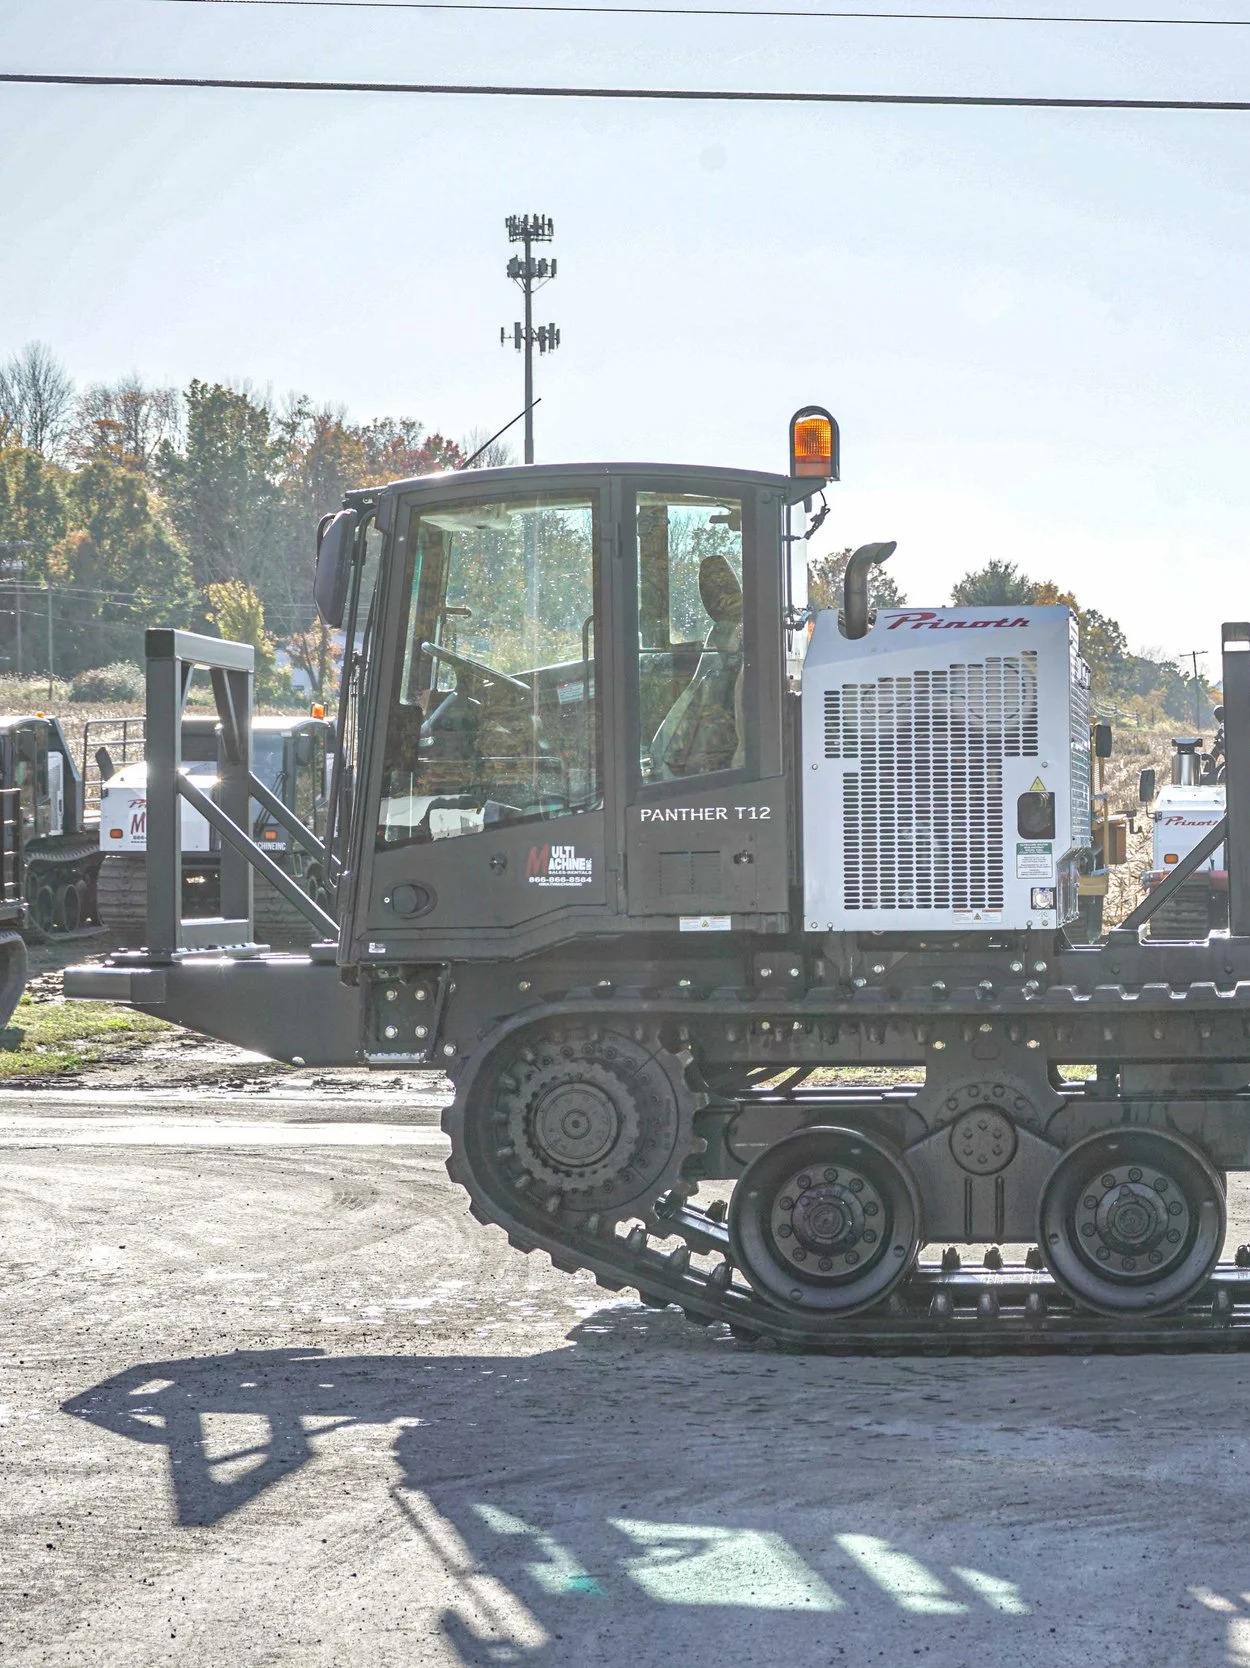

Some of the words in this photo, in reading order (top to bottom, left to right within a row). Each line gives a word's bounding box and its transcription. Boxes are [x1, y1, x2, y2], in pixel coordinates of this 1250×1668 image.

[884, 612, 1030, 629] Prinoth
[640, 808, 728, 821] PANTHER
[734, 807, 771, 820] T12
